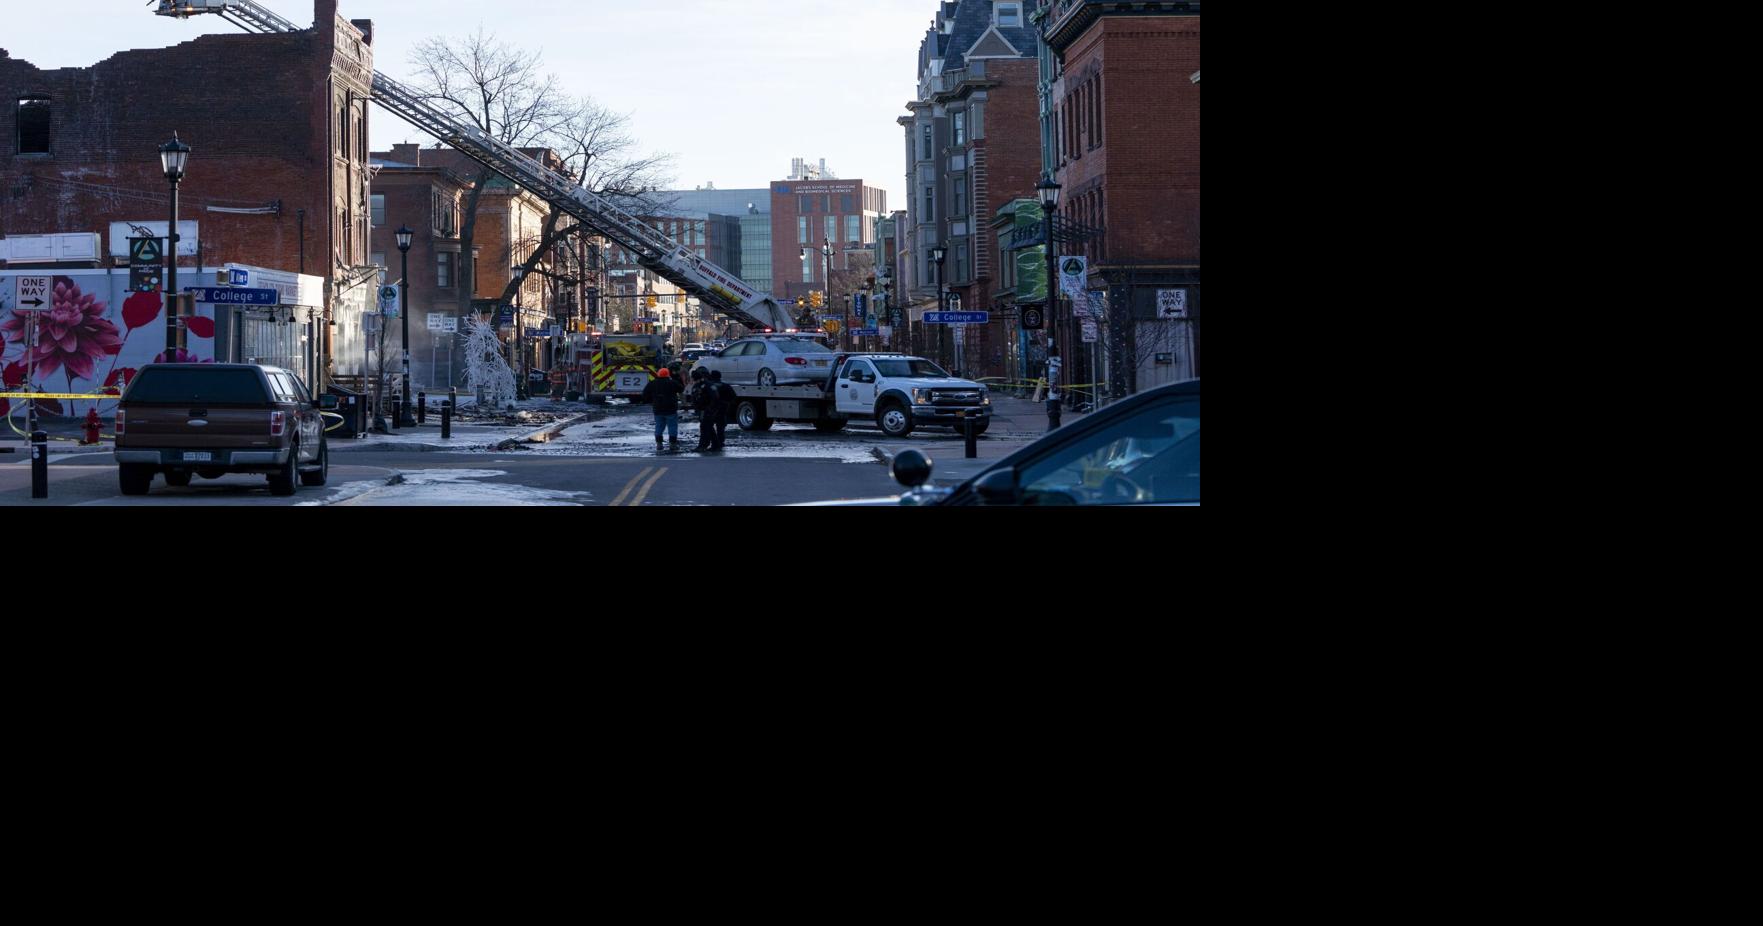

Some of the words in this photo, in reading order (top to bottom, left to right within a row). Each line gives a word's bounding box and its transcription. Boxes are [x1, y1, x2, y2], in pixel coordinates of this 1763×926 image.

[22, 278, 45, 287] ONE
[699, 264, 717, 279] BUFFALO
[717, 275, 727, 285] FIRE
[726, 281, 752, 299] DEPARTMENT
[21, 287, 46, 296] WAY
[1162, 291, 1181, 299] ONE
[213, 290, 253, 304] College
[944, 314, 971, 322] College
[622, 376, 641, 387] E2
